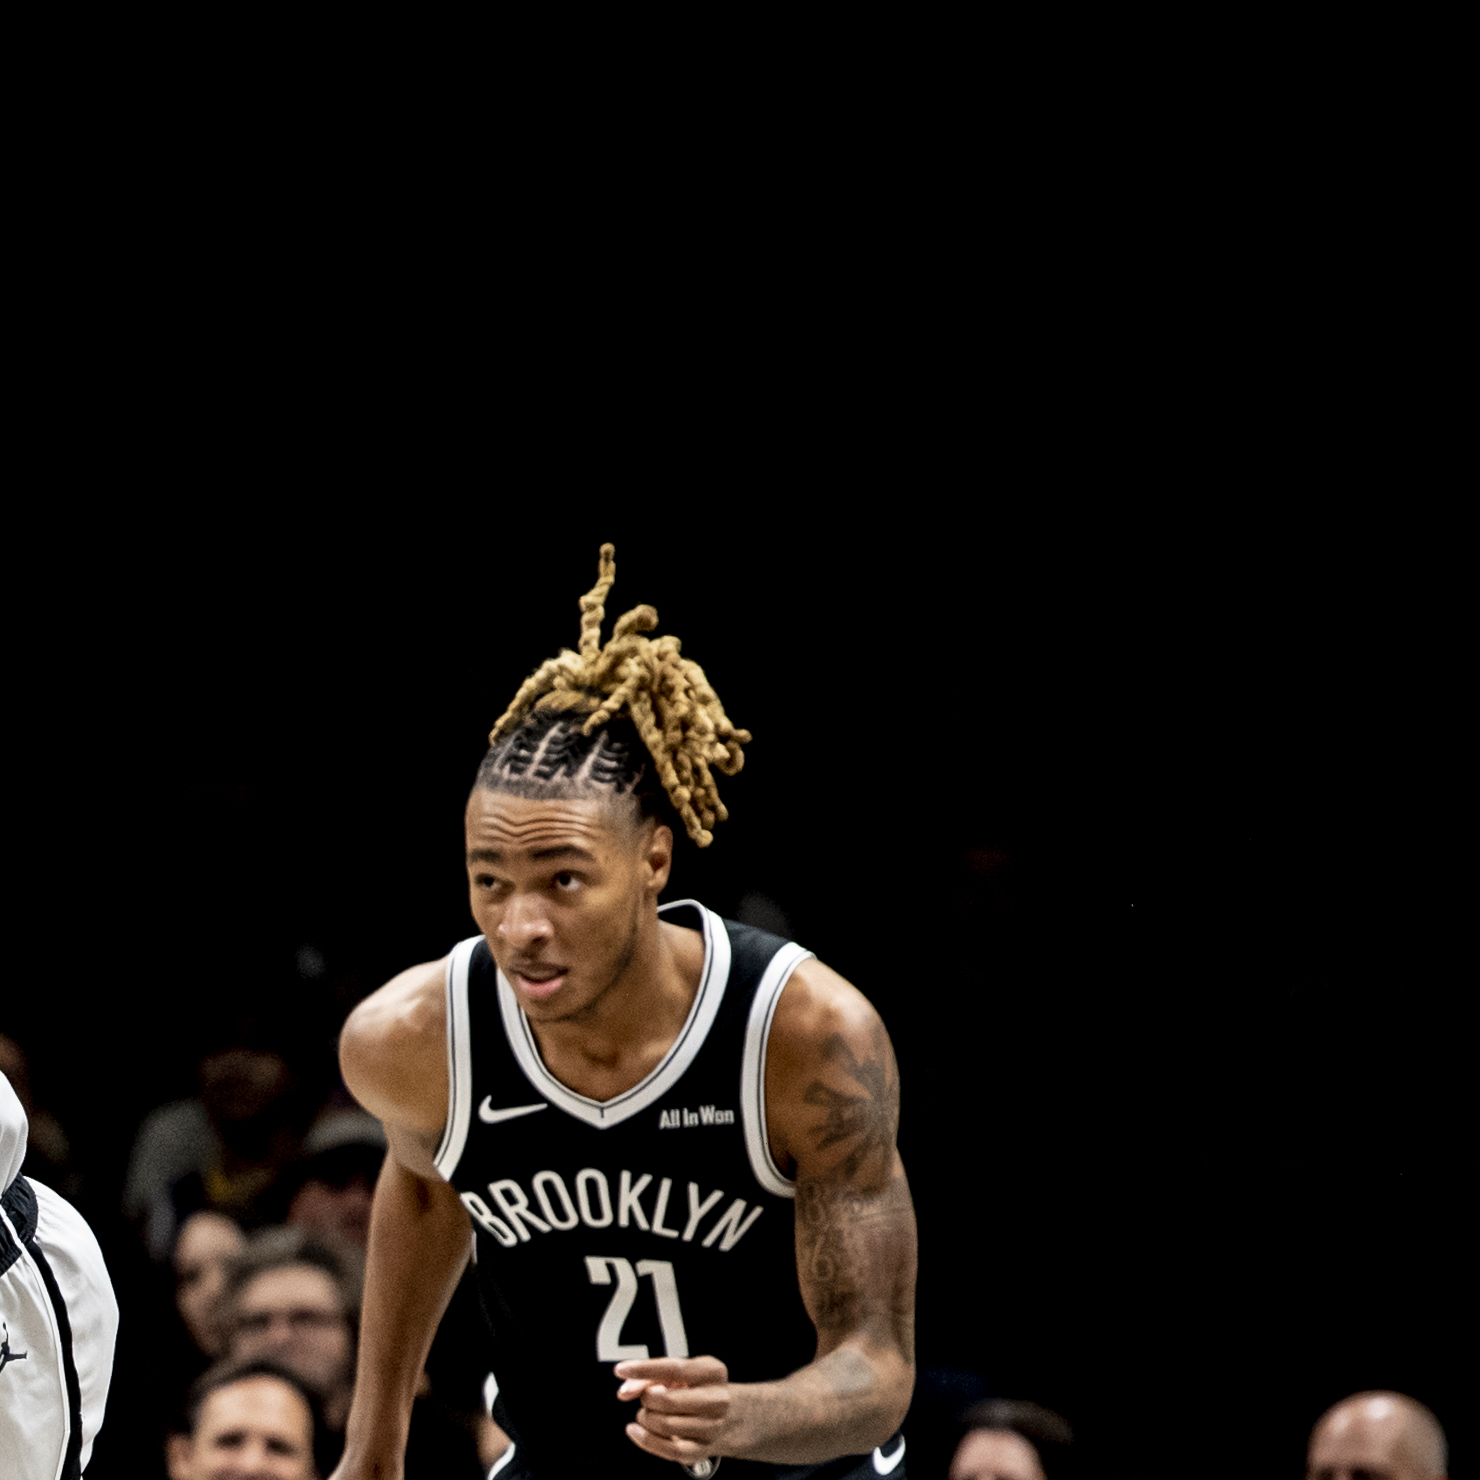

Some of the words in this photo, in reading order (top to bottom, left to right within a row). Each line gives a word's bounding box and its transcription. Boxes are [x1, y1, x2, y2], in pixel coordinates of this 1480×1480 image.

[658, 1108, 681, 1130] All
[460, 1167, 764, 1252] BROOKLYN
[584, 1255, 690, 1362] 21
